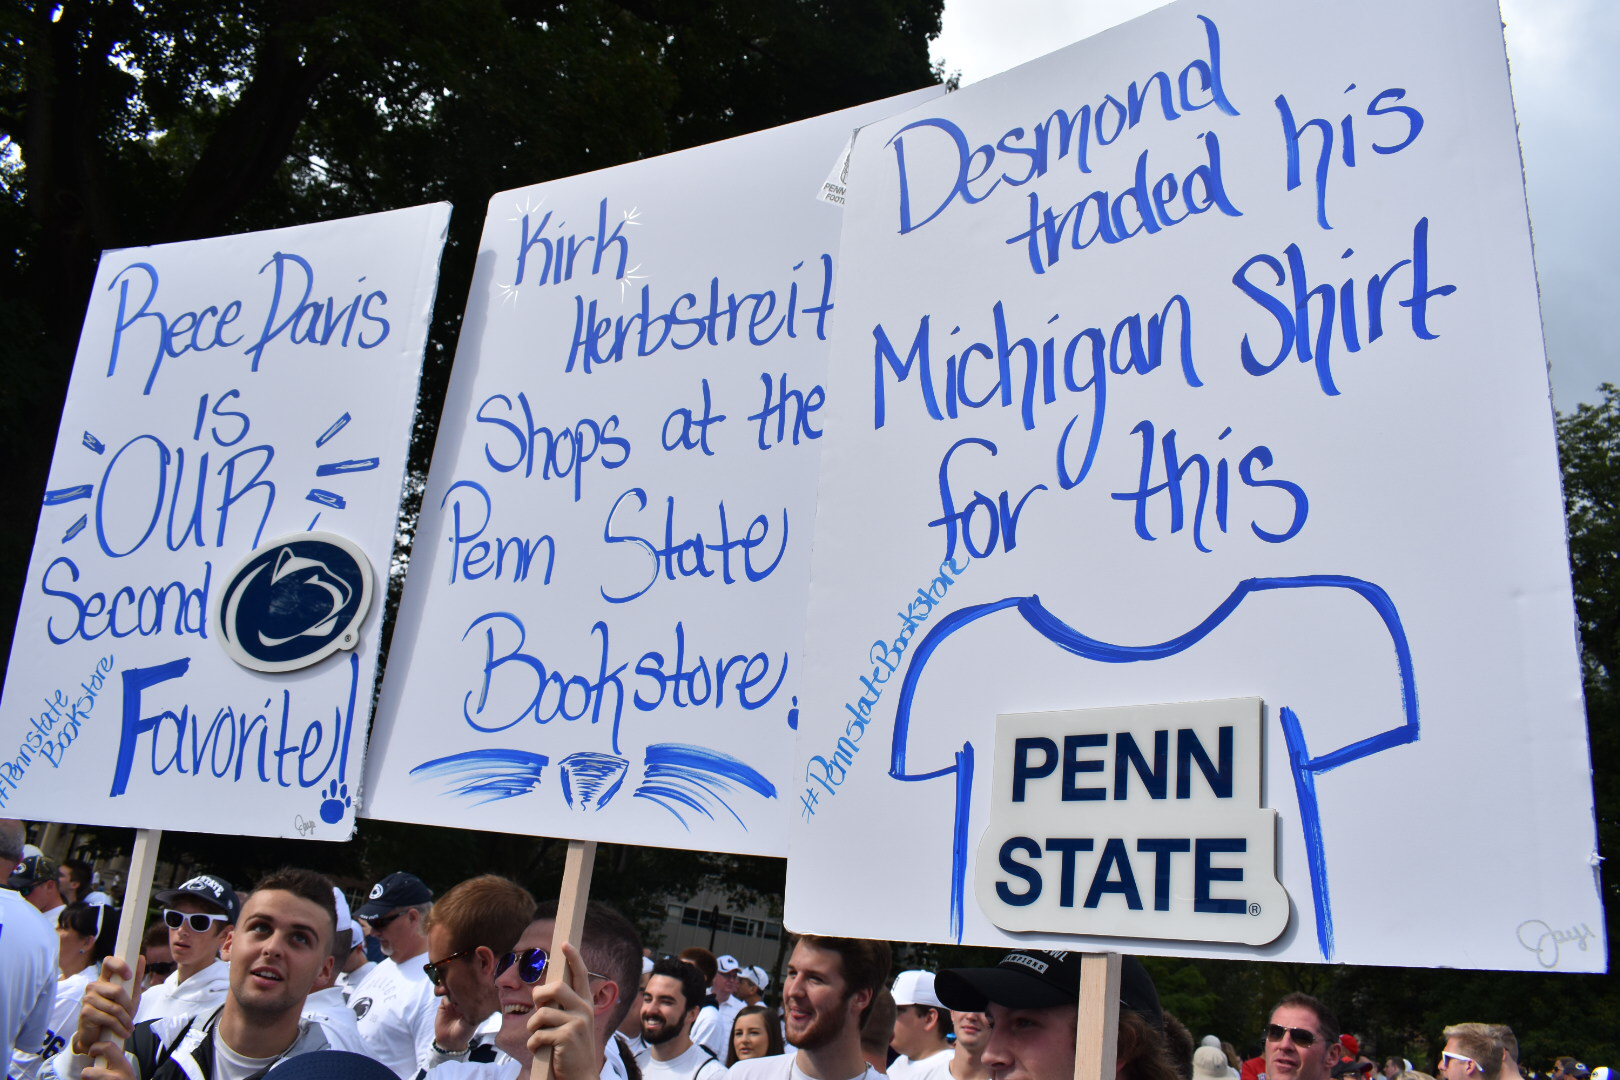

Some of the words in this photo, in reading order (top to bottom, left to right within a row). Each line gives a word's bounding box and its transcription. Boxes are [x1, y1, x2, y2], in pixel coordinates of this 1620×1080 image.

[884, 14, 1240, 235] Desmond
[1006, 131, 1243, 274] traded
[1275, 83, 1424, 230] his
[515, 197, 628, 286] Kirk
[823, 183, 846, 195] PENN
[825, 193, 845, 204] FOOT
[108, 262, 244, 395] Rece
[245, 252, 390, 372] Davis
[565, 254, 834, 374] Herbstreit
[873, 295, 1204, 490] Michigan
[1233, 217, 1456, 396] Shirt
[95, 434, 276, 558] OUR
[476, 391, 630, 502] Shops
[662, 379, 726, 456] at
[748, 373, 825, 450] the
[928, 437, 1048, 562] for
[1112, 420, 1309, 553] this
[42, 557, 212, 645] Second
[440, 480, 554, 585] Penn
[600, 487, 788, 603] State
[110, 652, 358, 798] Favorite!
[1011, 725, 1234, 803] PENN
